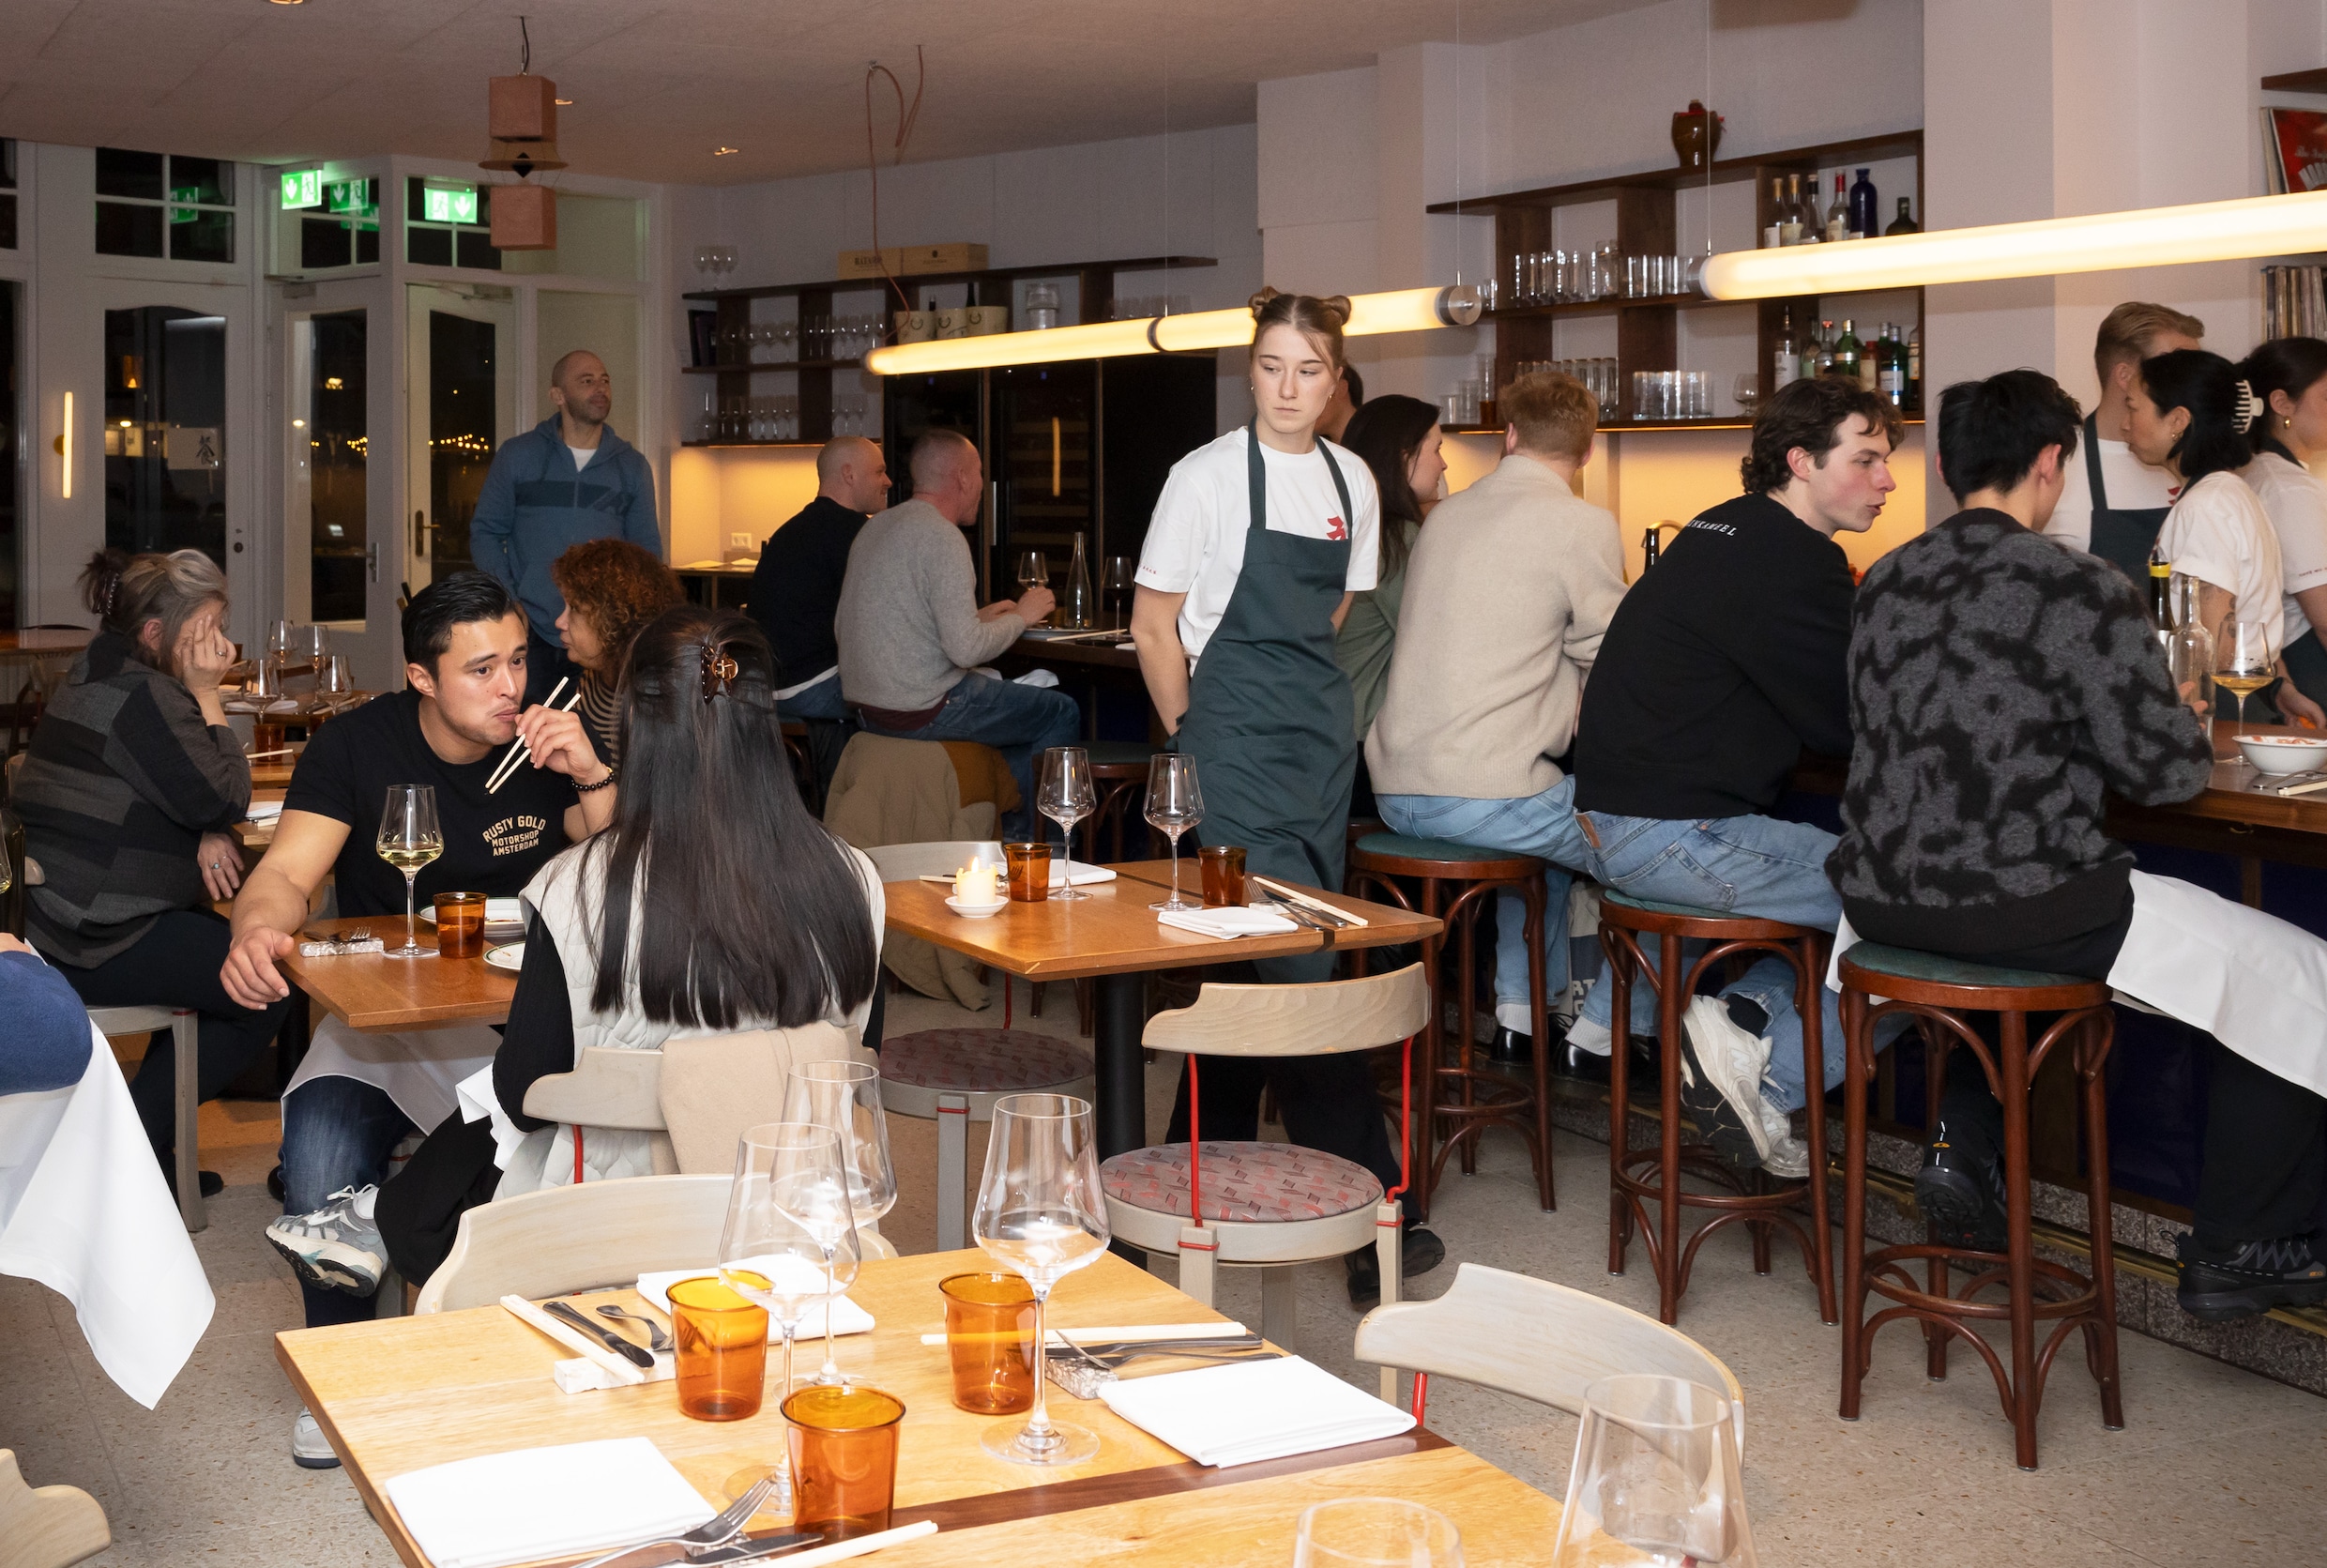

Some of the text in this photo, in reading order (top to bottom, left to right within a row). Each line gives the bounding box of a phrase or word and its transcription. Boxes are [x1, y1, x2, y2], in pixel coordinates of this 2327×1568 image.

[482, 815, 546, 843] RUSTY GOLD
[492, 830, 540, 847] MOTORSHOP
[493, 838, 540, 857] AMSTERDAM
